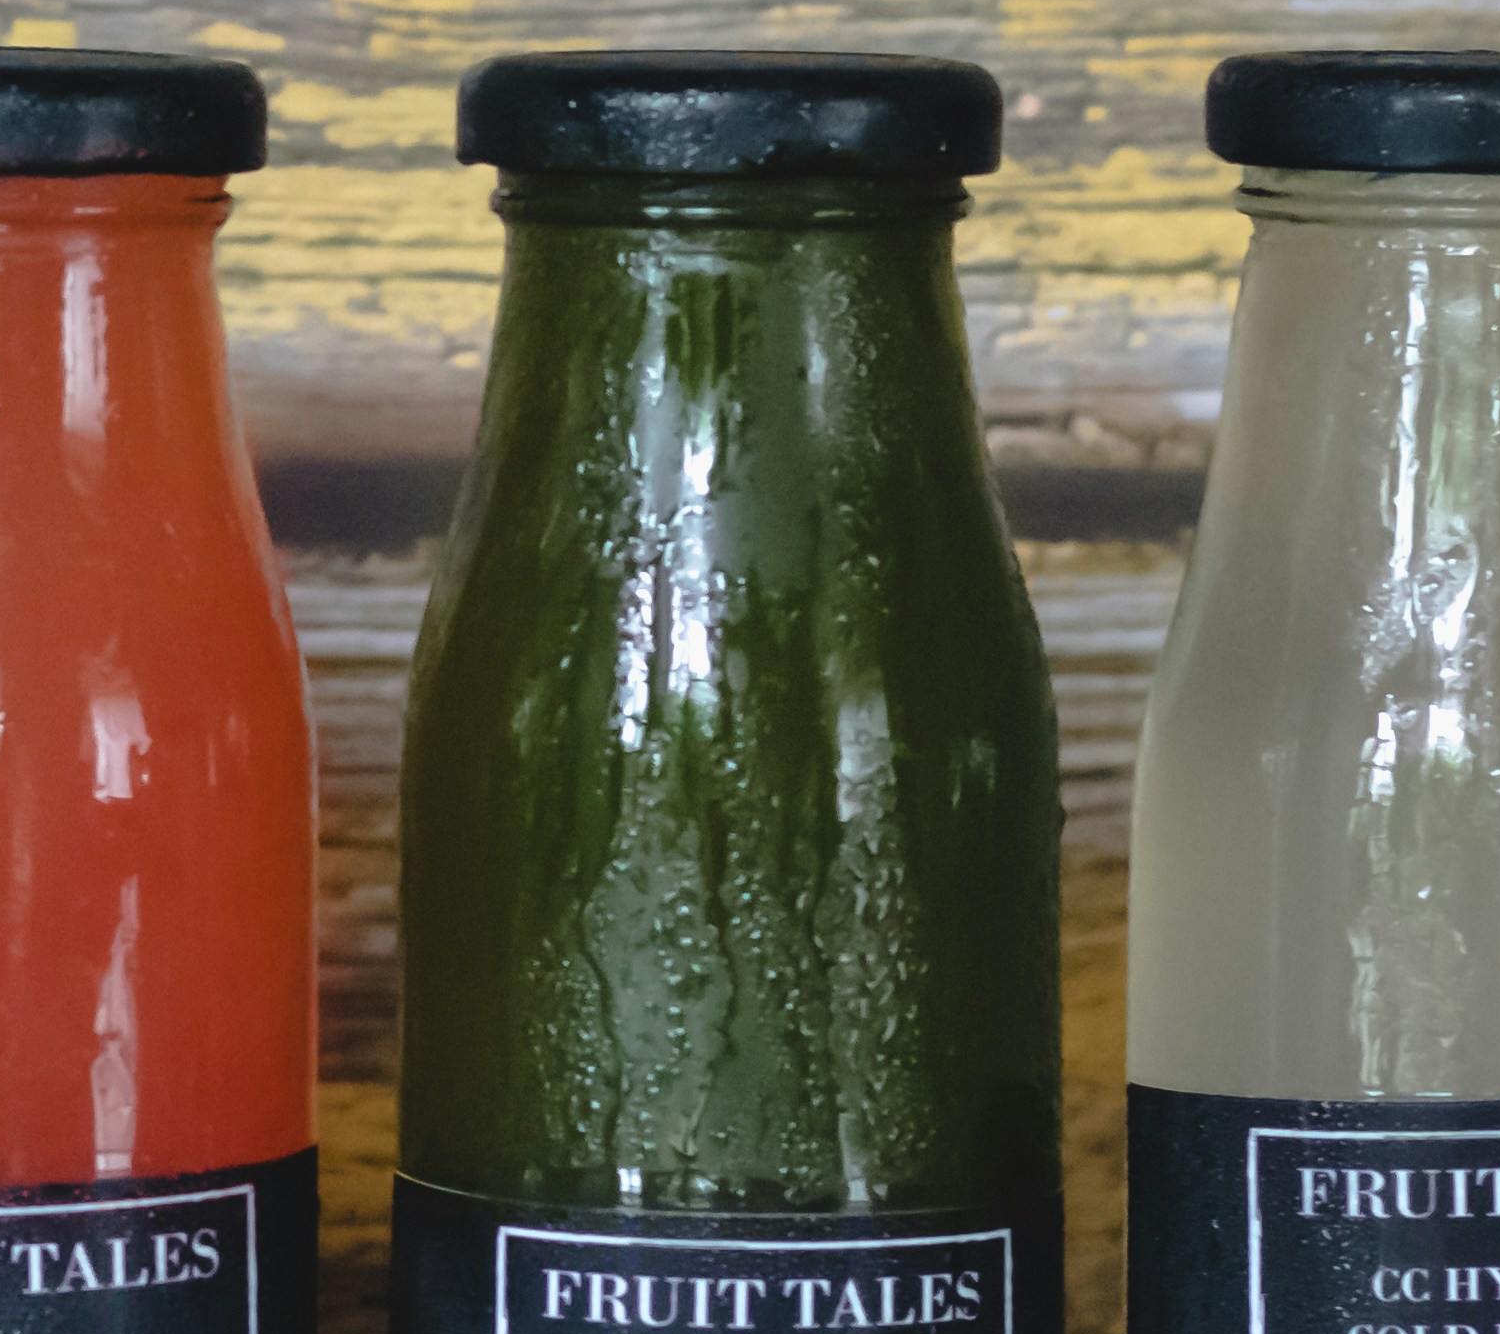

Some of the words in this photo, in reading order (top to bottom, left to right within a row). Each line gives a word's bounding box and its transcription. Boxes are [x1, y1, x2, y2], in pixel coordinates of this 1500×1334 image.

[10, 1228, 220, 1296] TALES
[1371, 1267, 1431, 1302] CC
[542, 1268, 766, 1328] FRUIT
[783, 1271, 980, 1329] TALES
